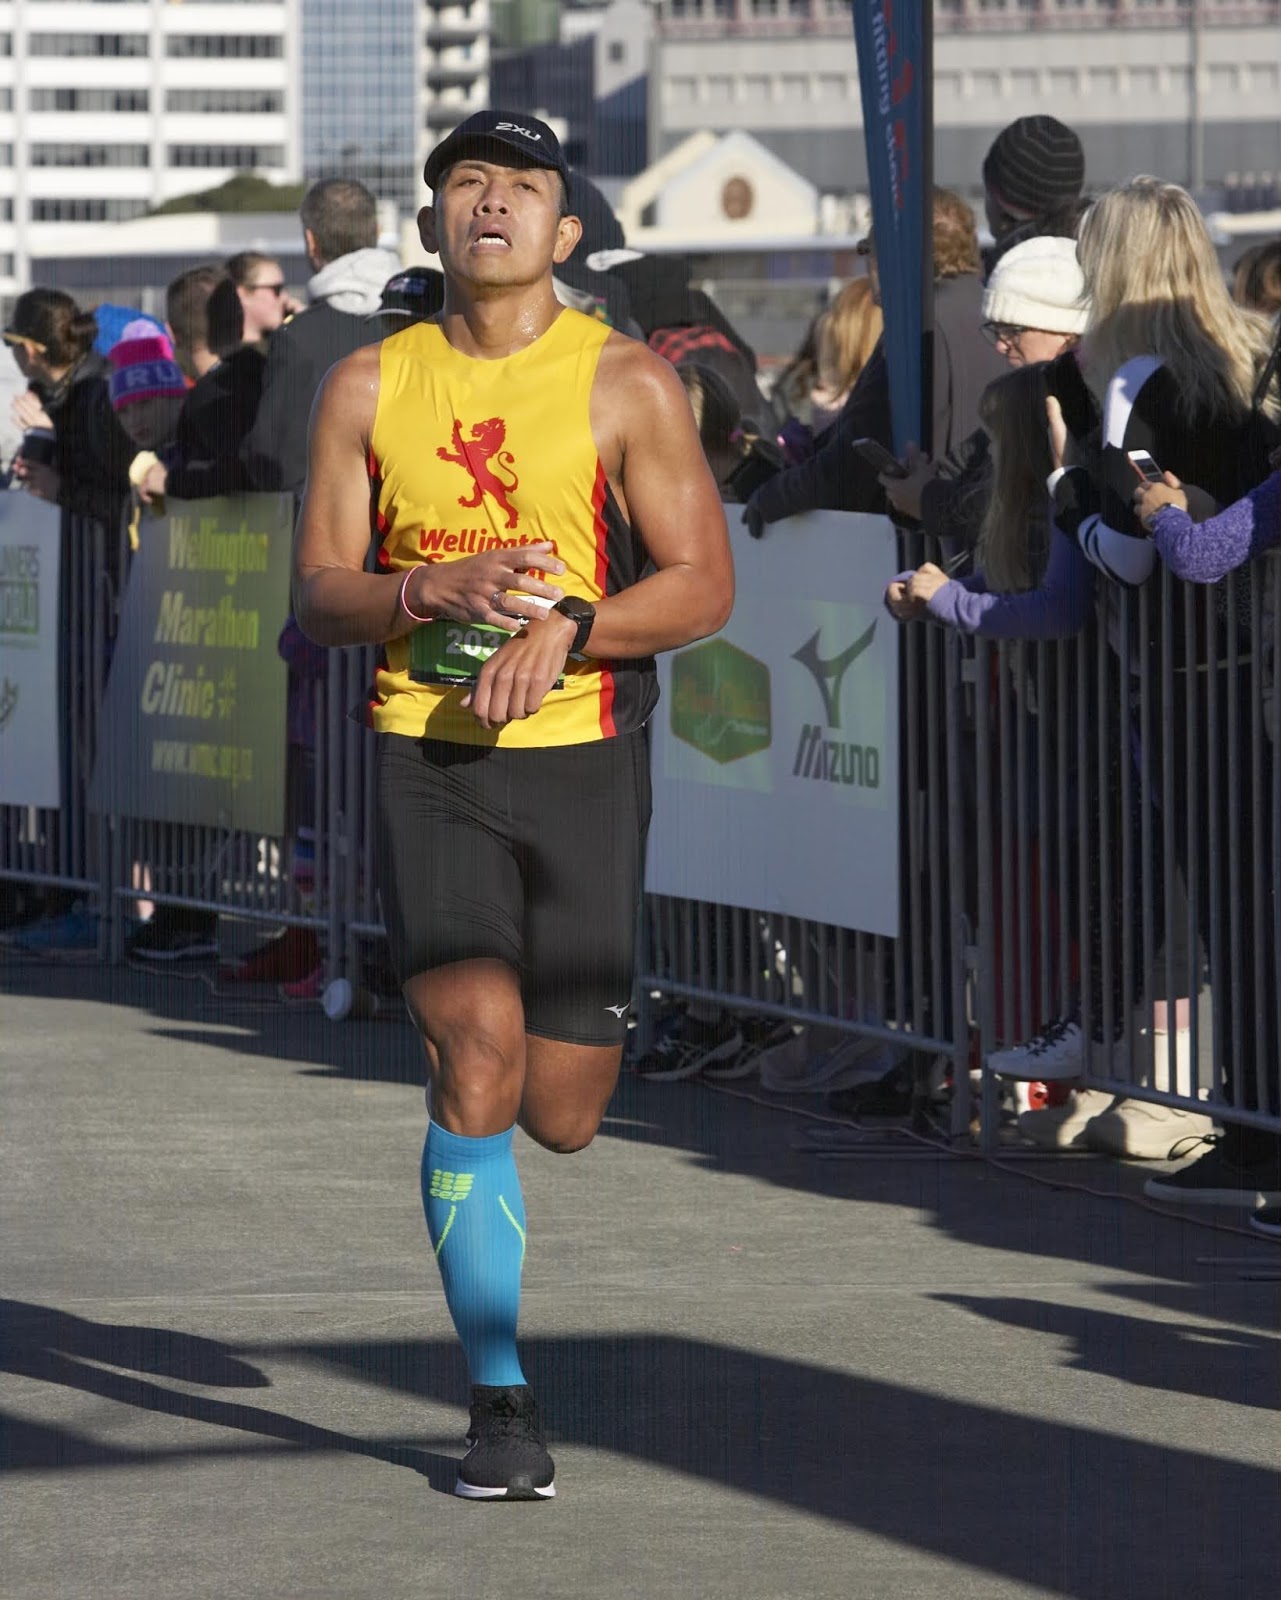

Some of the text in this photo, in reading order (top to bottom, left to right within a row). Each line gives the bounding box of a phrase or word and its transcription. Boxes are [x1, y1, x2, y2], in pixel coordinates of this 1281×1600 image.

[168, 515, 268, 586] Wellington
[152, 590, 259, 650] Marathon
[141, 660, 215, 719] Clinic
